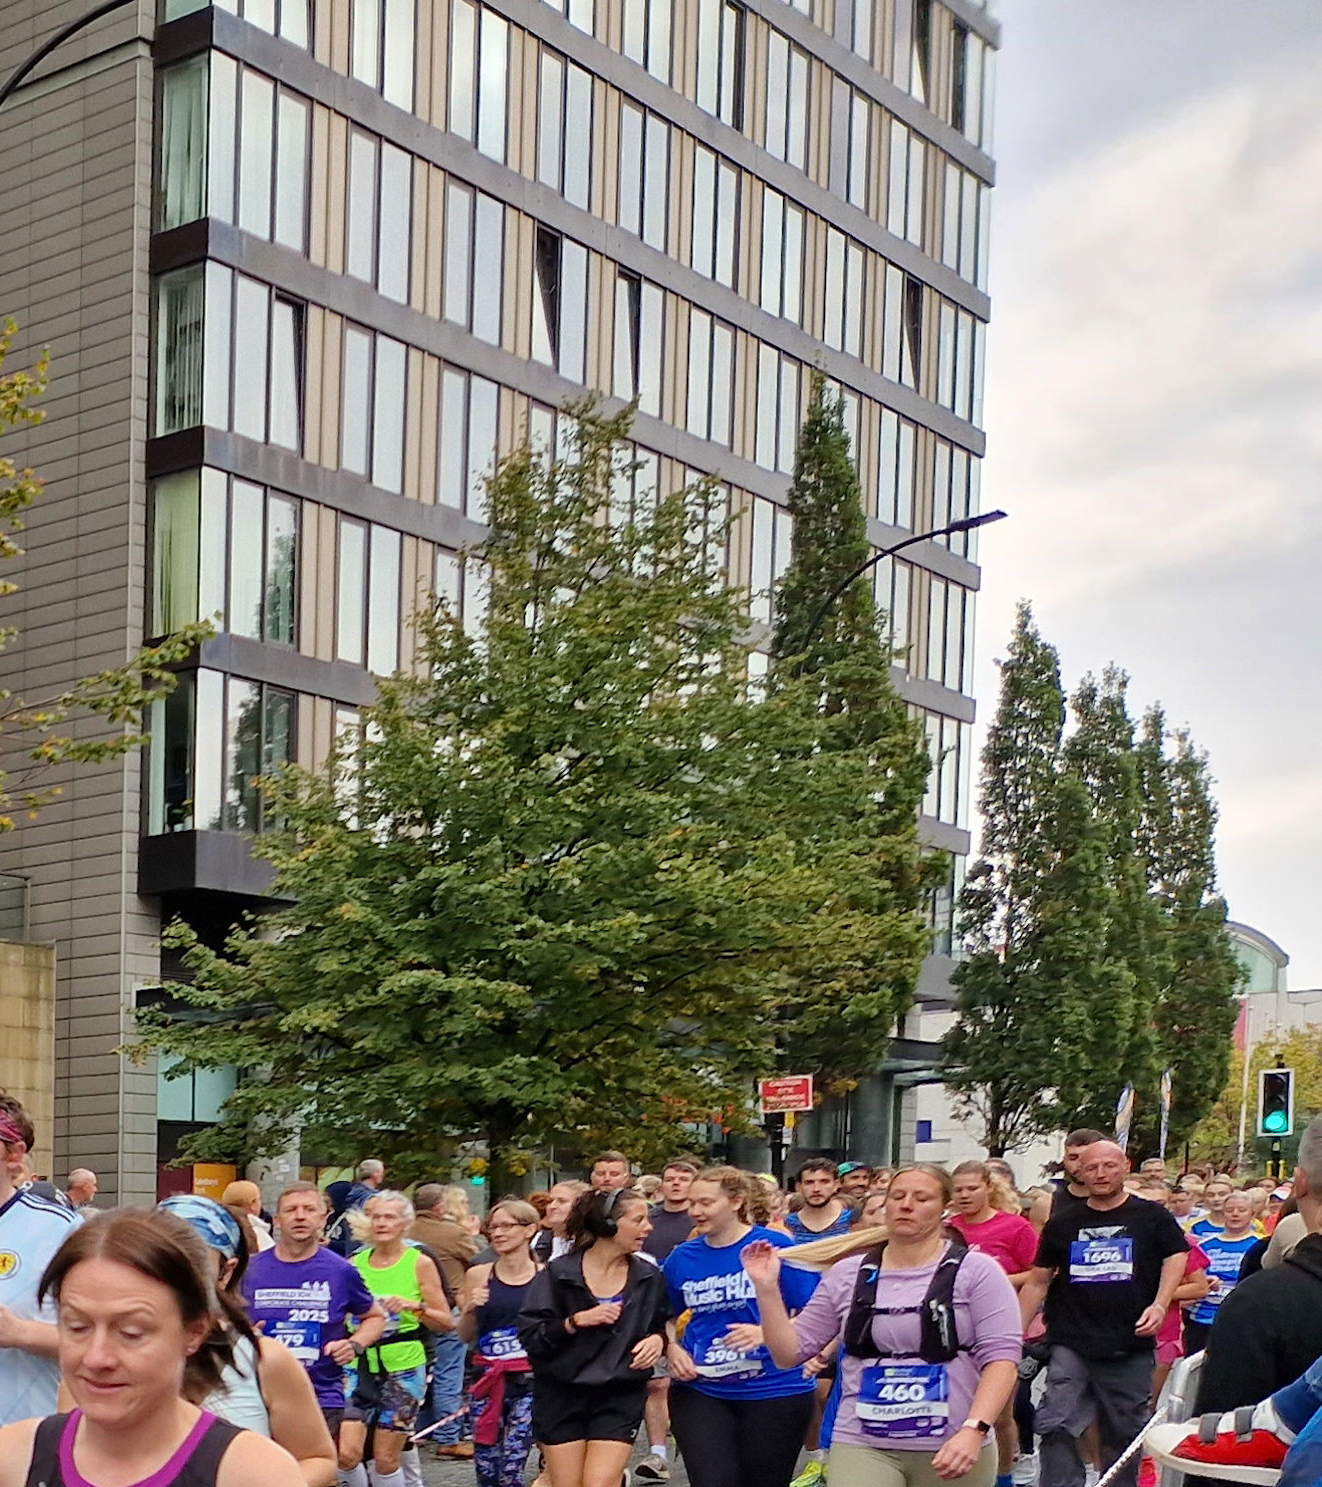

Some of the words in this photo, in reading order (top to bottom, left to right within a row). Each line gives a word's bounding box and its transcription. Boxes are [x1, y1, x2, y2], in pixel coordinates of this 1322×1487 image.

[1083, 1251, 1122, 1263] 1696
[289, 1309, 329, 1323] 2025
[878, 1384, 926, 1402] 460
[872, 1405, 932, 1415] CHARLOTTE
